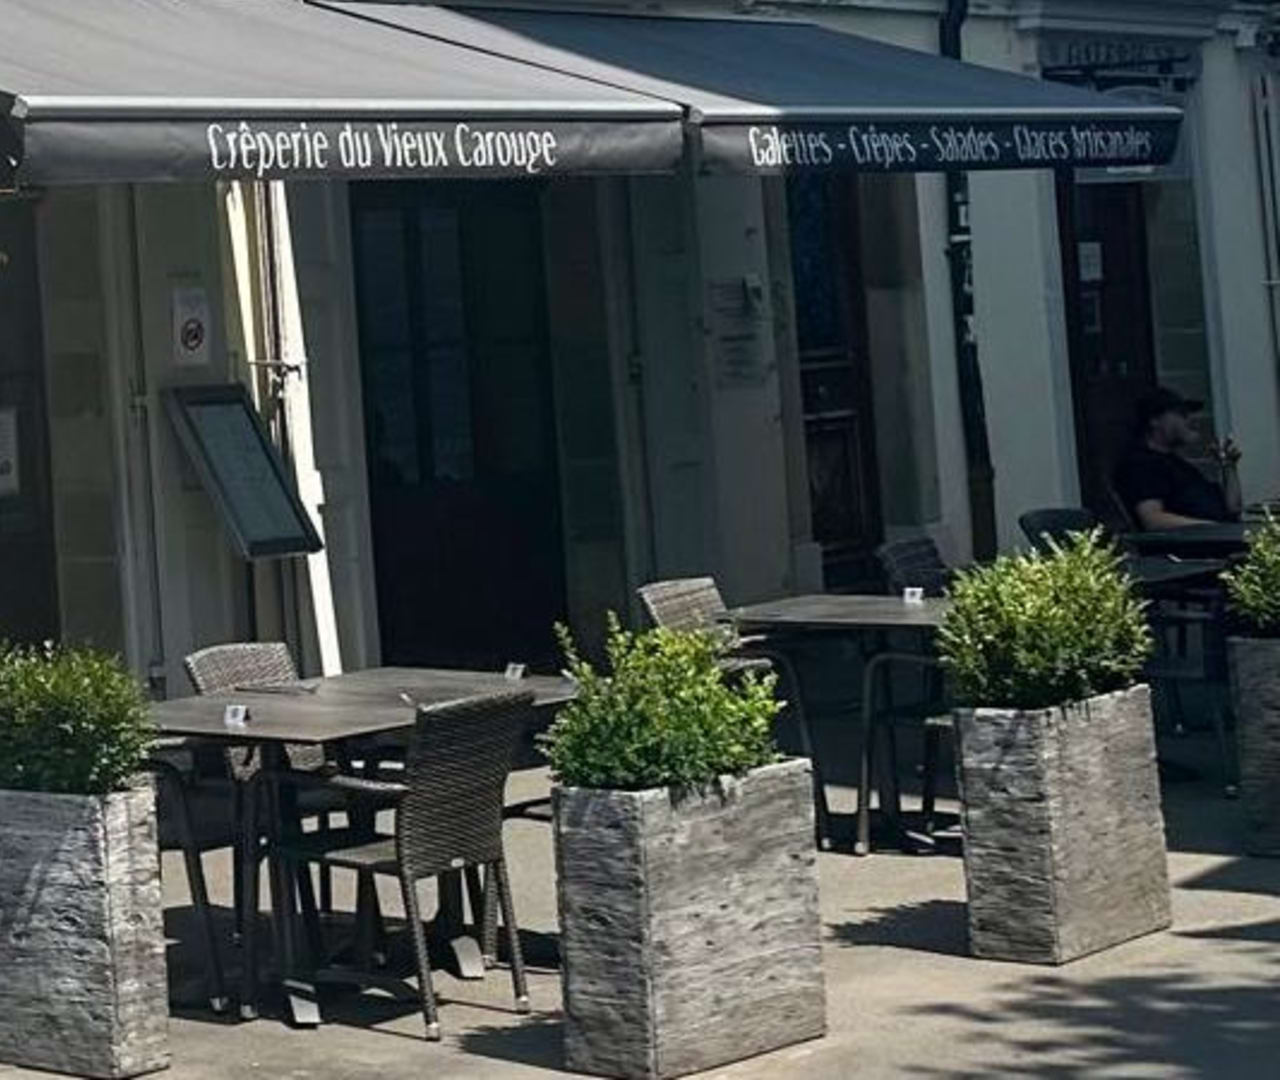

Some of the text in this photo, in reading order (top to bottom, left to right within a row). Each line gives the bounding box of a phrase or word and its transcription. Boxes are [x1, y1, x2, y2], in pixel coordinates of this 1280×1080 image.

[206, 120, 558, 177] Crêperie du Vieux Carouge
[748, 126, 833, 166] Galettes
[848, 125, 917, 169] Crêpes
[930, 125, 1000, 163] Salades
[1013, 125, 1070, 161] Glaces
